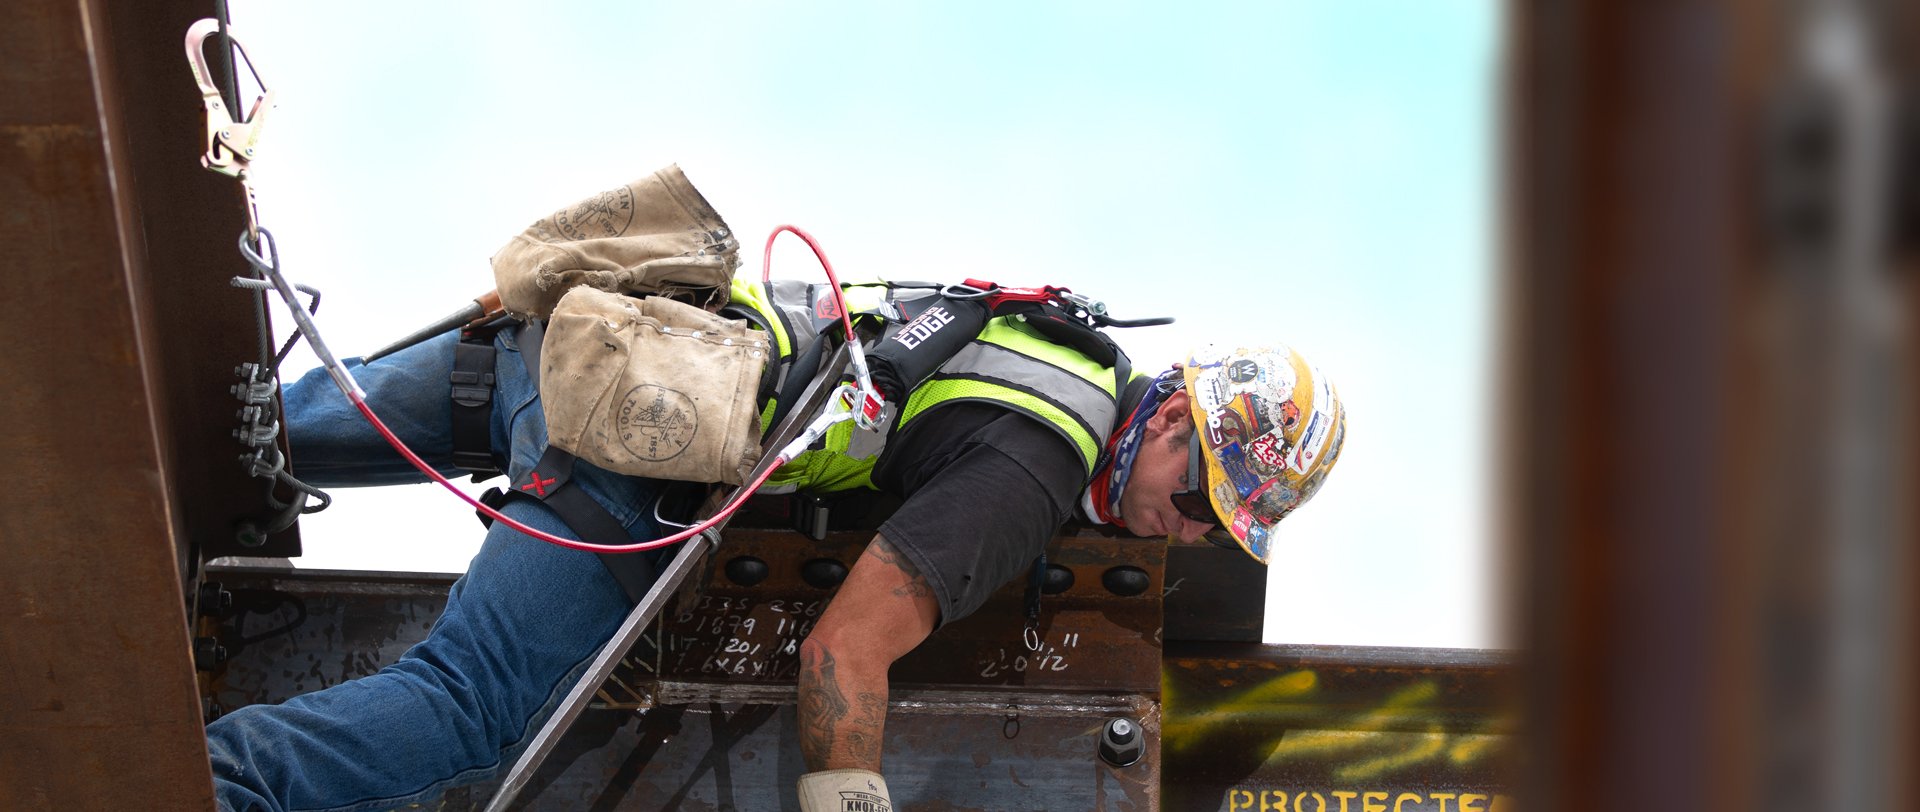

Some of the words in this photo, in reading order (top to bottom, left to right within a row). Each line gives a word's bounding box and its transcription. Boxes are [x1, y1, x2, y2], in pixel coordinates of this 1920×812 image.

[891, 306, 940, 341] LEADING
[897, 307, 956, 351] EDGE
[620, 399, 637, 441] TOOLS
[649, 435, 658, 459] 1857
[1229, 789, 1515, 812] PROTECTE
